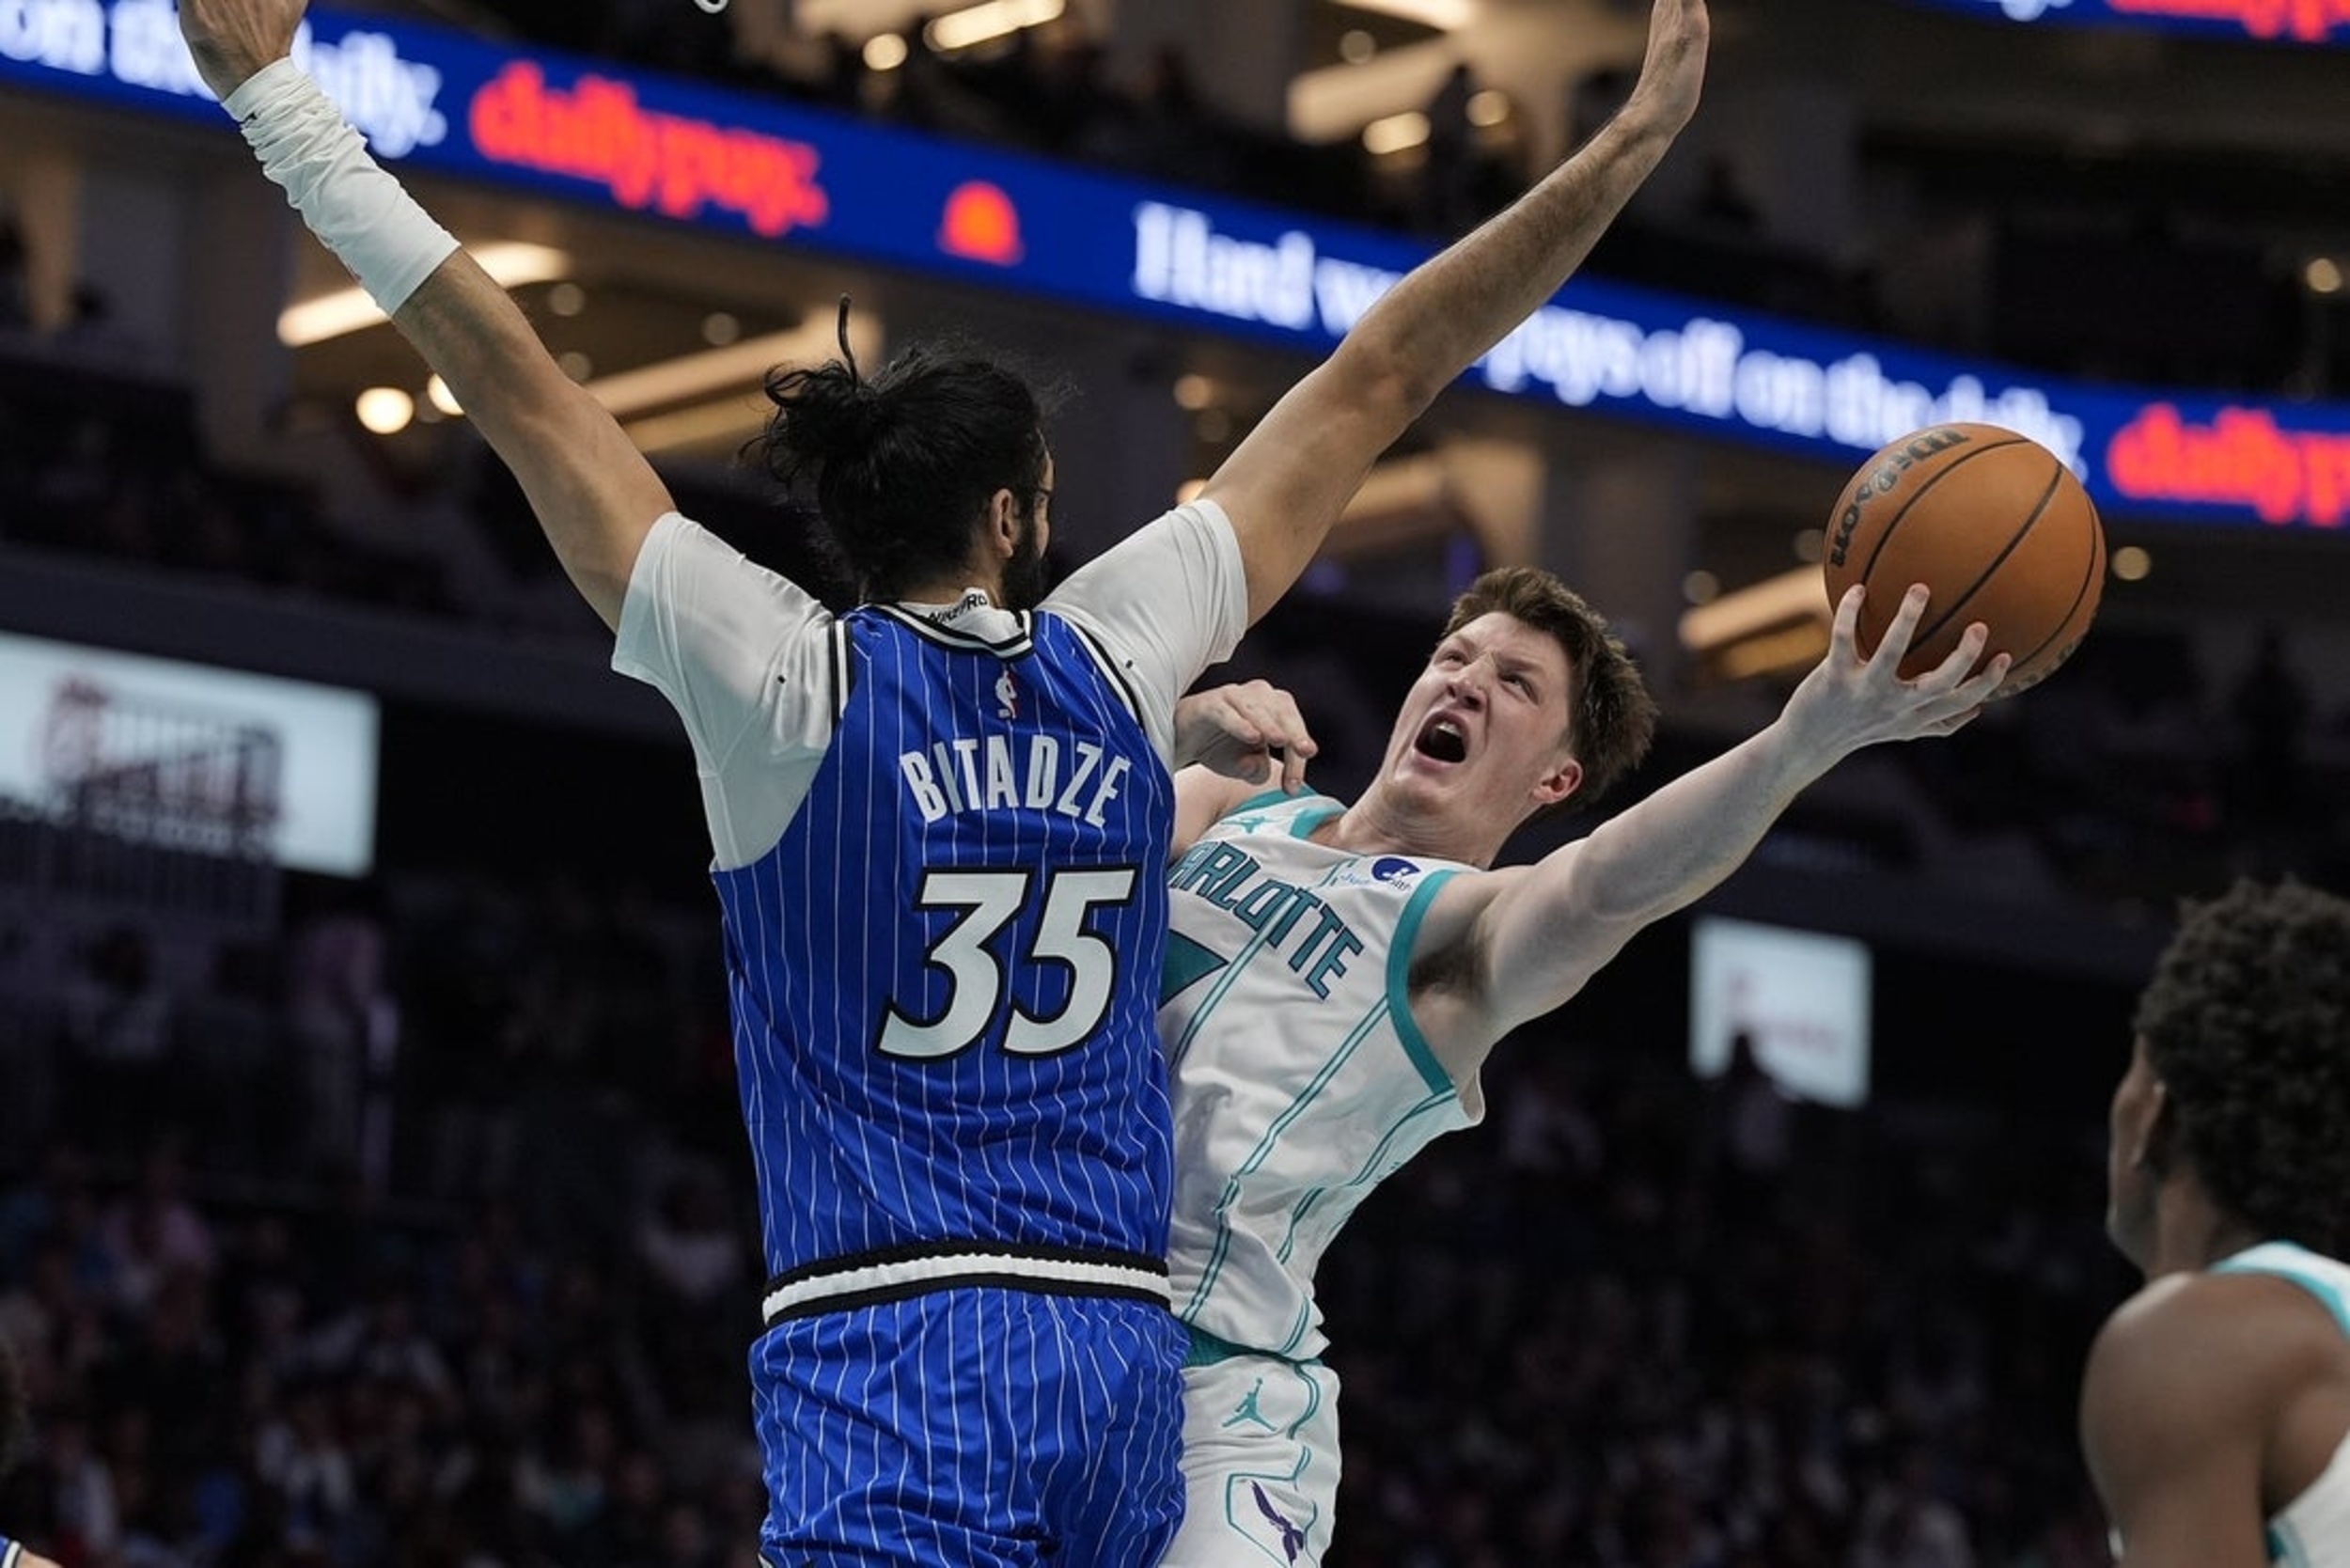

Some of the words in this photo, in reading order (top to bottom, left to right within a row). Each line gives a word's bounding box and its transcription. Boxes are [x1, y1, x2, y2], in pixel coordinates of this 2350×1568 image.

[1131, 200, 1315, 331] Hard
[1639, 317, 1745, 420] off
[1735, 350, 1826, 439] on
[900, 734, 1131, 827] BITADZE
[874, 864, 1141, 1061] 35
[1166, 841, 1365, 1001] ARLOTTE
